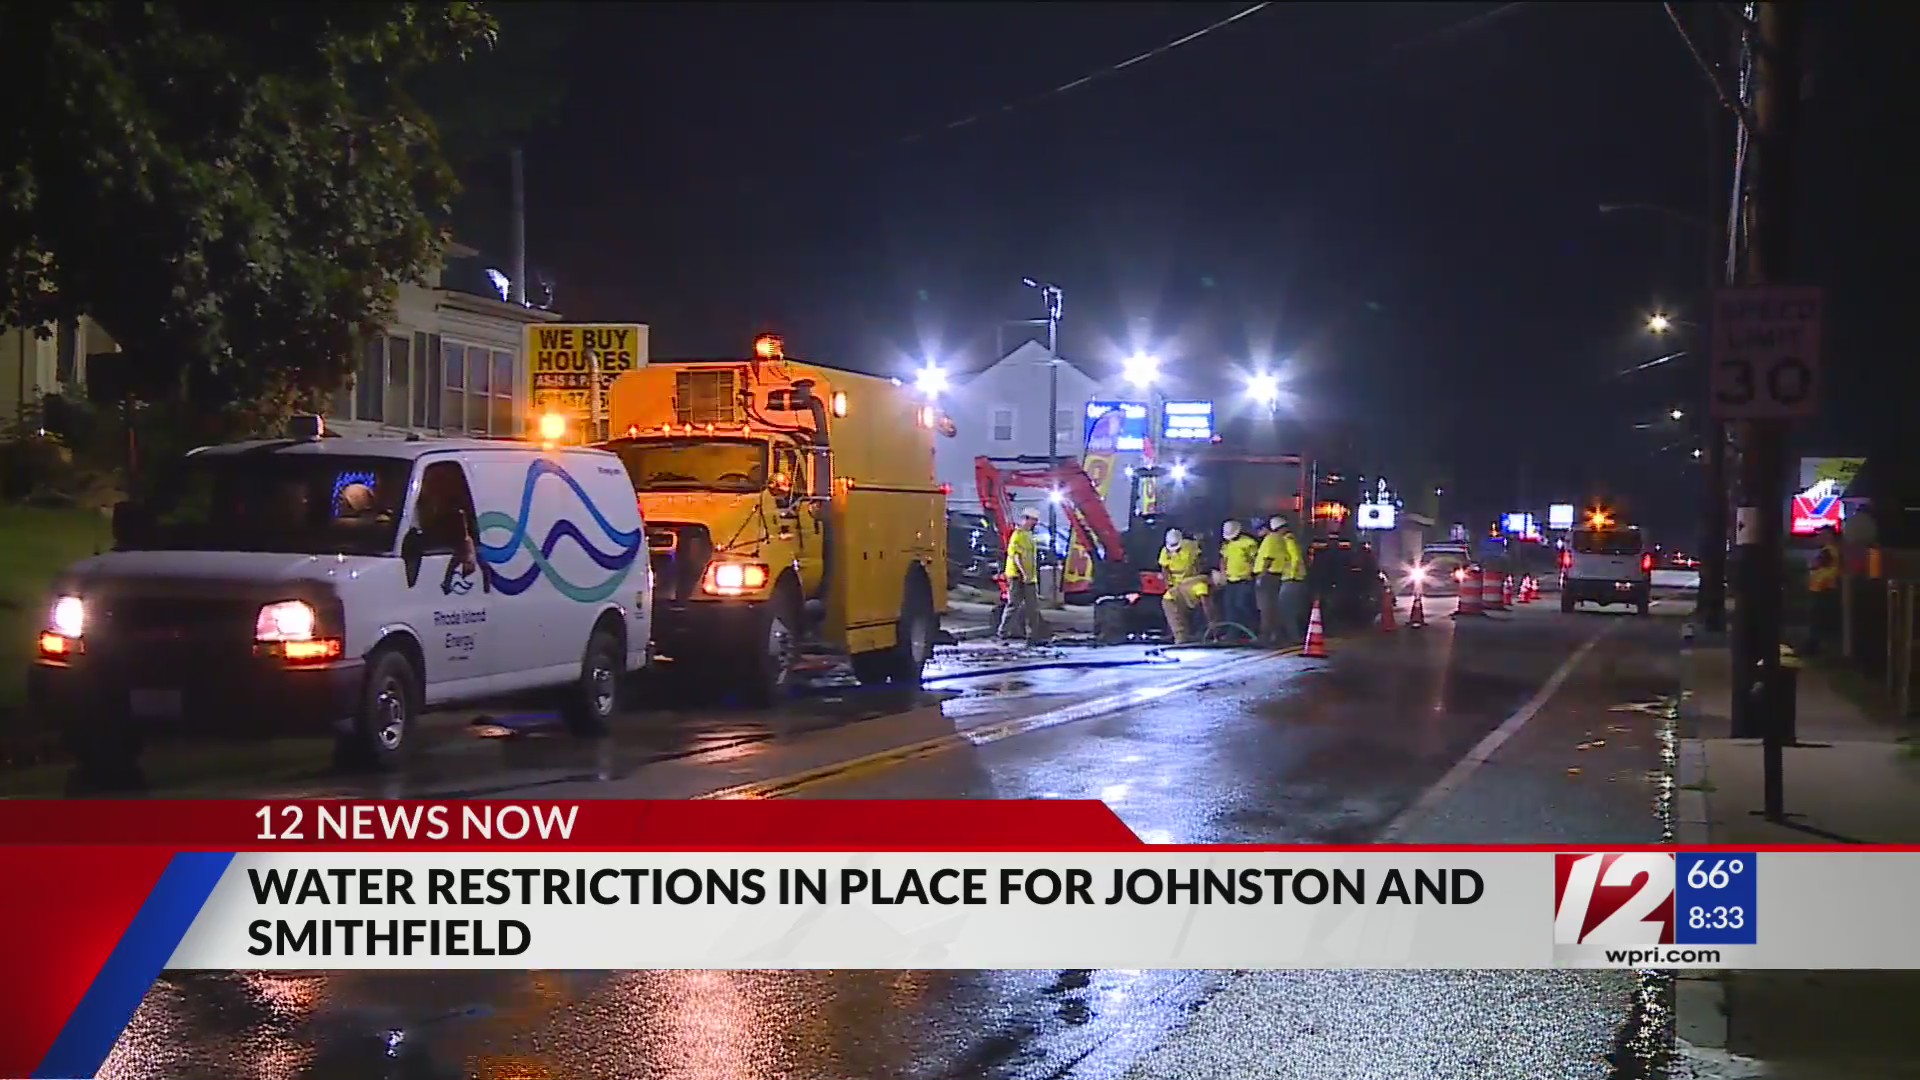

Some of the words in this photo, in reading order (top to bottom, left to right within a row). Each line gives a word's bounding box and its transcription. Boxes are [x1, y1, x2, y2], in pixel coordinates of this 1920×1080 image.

[539, 329, 573, 350] WE
[582, 329, 629, 350] BUY
[1717, 356, 1811, 405] 30
